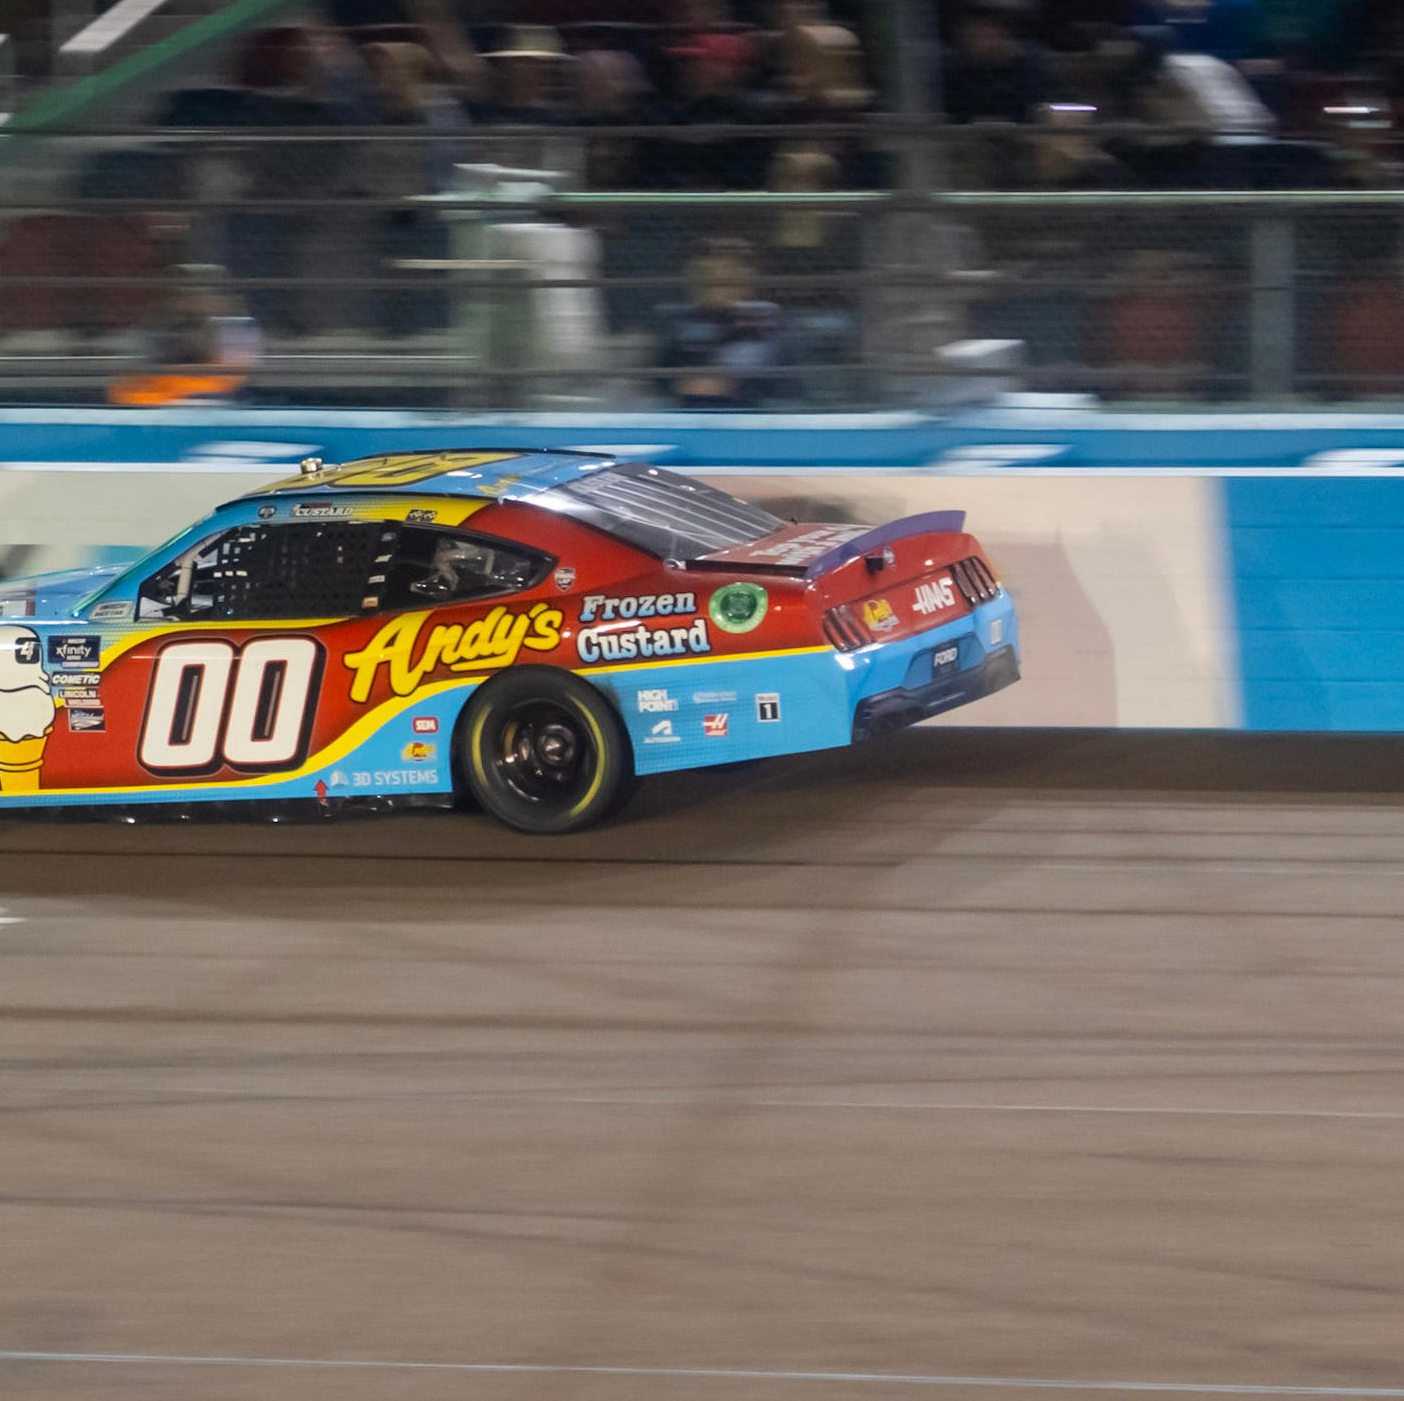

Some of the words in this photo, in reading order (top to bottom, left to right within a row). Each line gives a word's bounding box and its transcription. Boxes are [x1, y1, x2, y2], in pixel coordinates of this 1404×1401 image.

[578, 591, 697, 623] Frozen
[55, 644, 92, 658] xfinity
[343, 602, 565, 703] Andy's
[576, 619, 712, 664] Custard
[933, 647, 958, 667] FORD
[52, 674, 101, 685] COMETIC
[139, 636, 323, 775] 00
[353, 771, 372, 787] 3D
[374, 769, 439, 786] SYSTEMS
